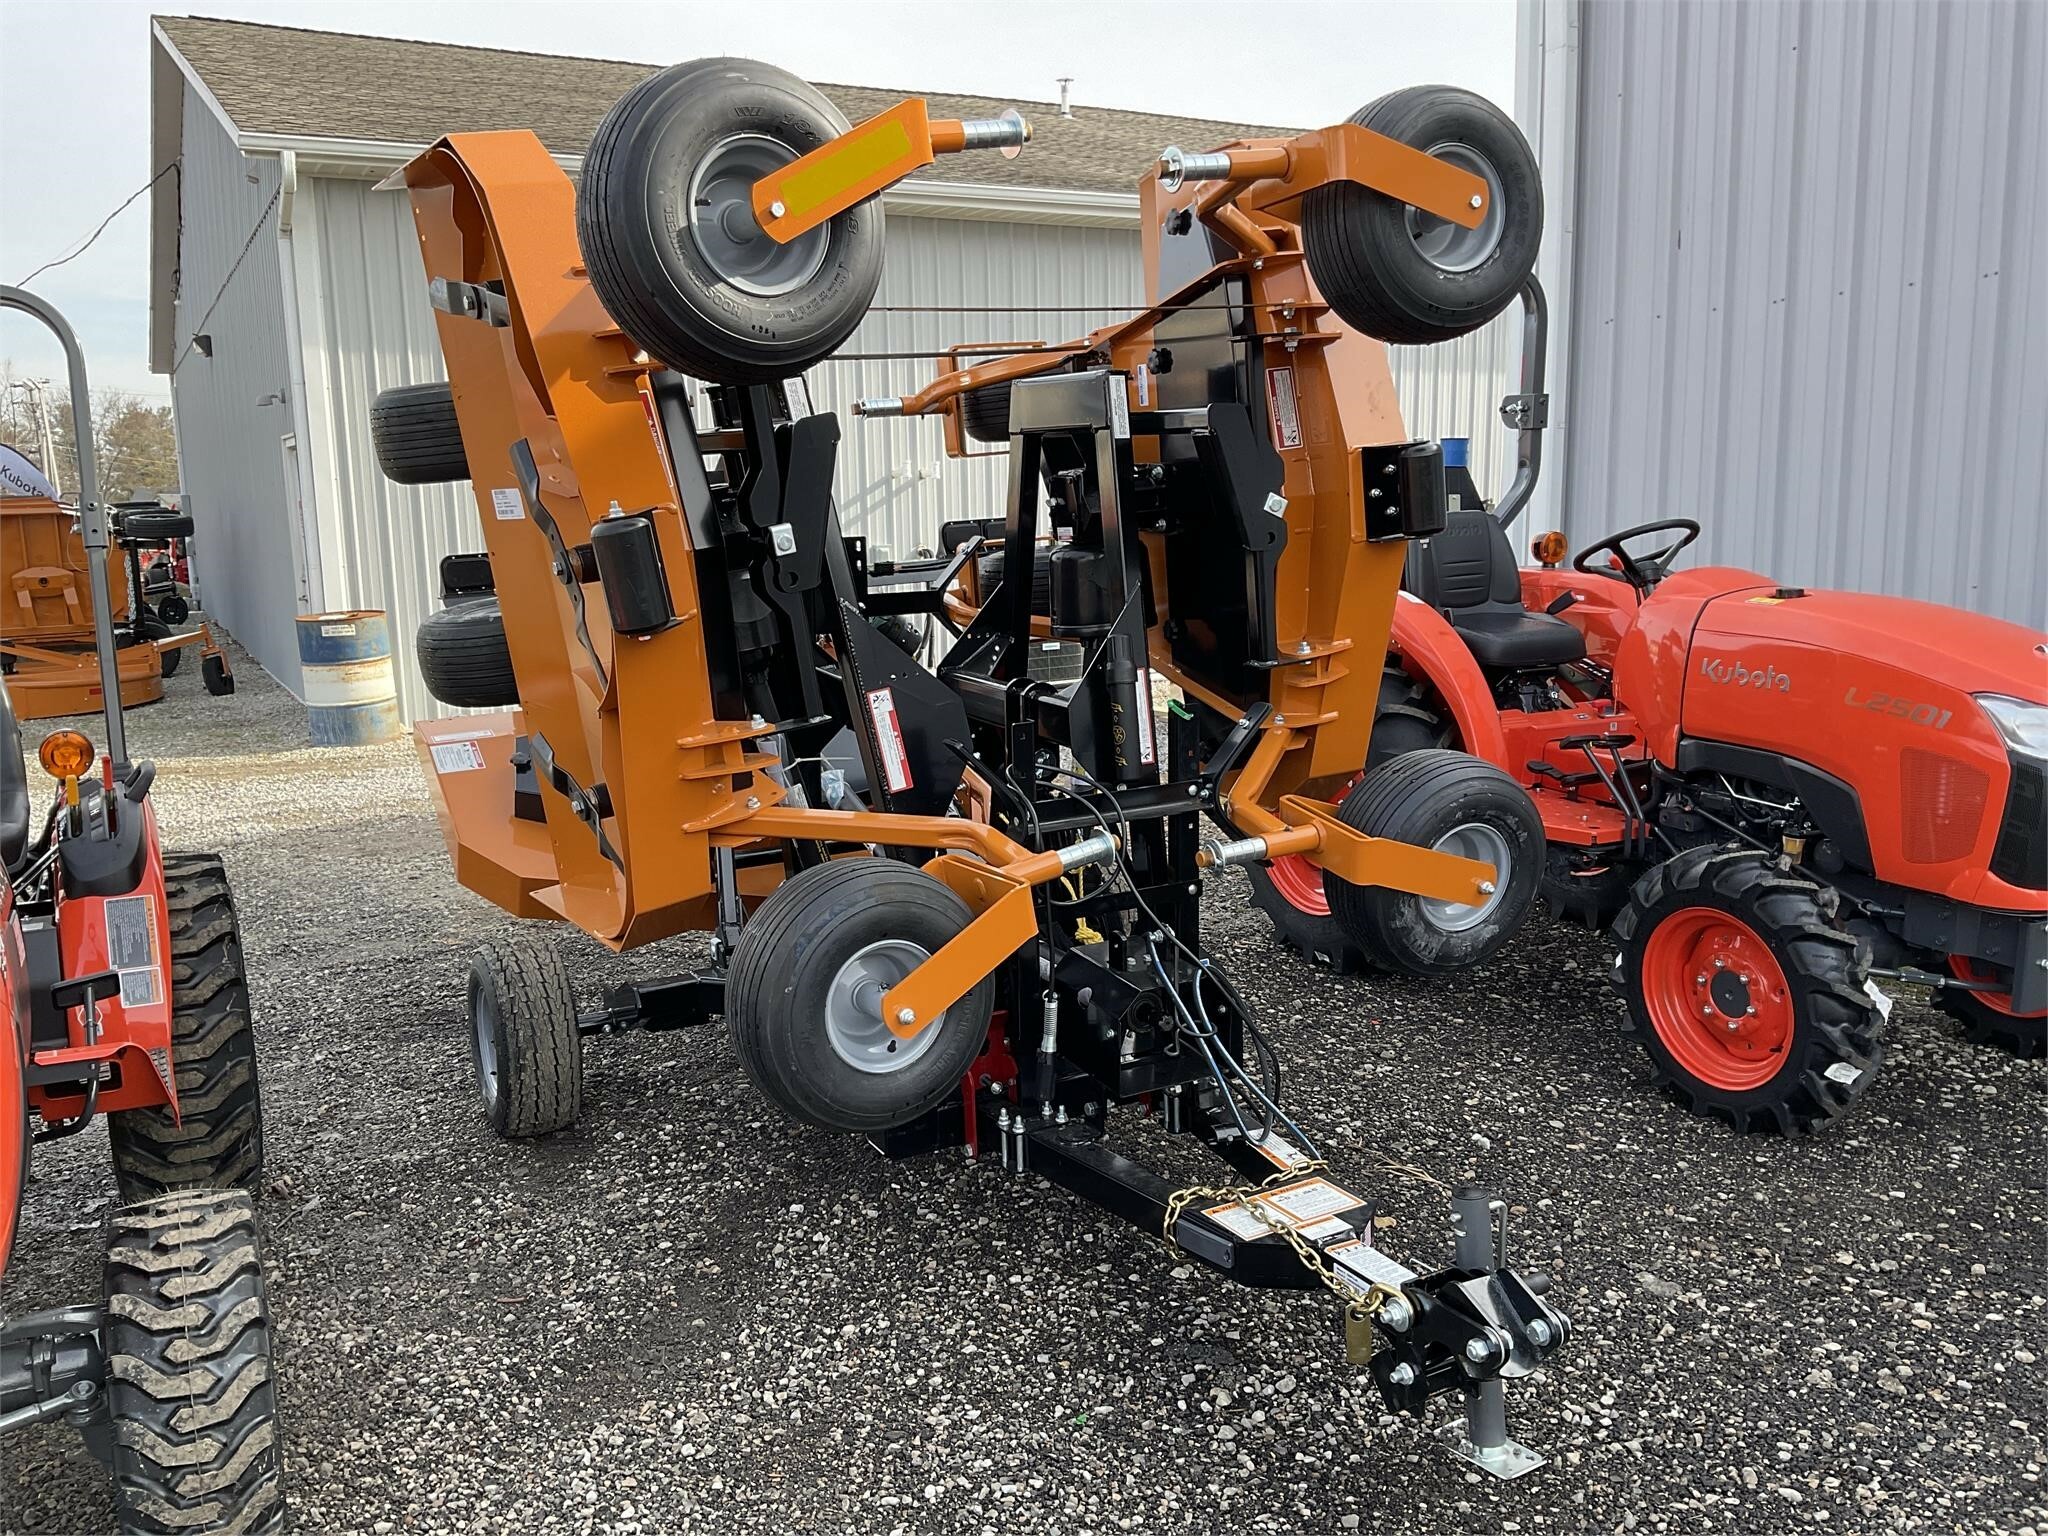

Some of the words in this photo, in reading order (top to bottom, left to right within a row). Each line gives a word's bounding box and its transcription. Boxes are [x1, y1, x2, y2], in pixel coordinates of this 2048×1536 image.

[1701, 657, 1791, 693] Kubota
[1844, 687, 1953, 730] L2501
[895, 736, 905, 761] DANGER
